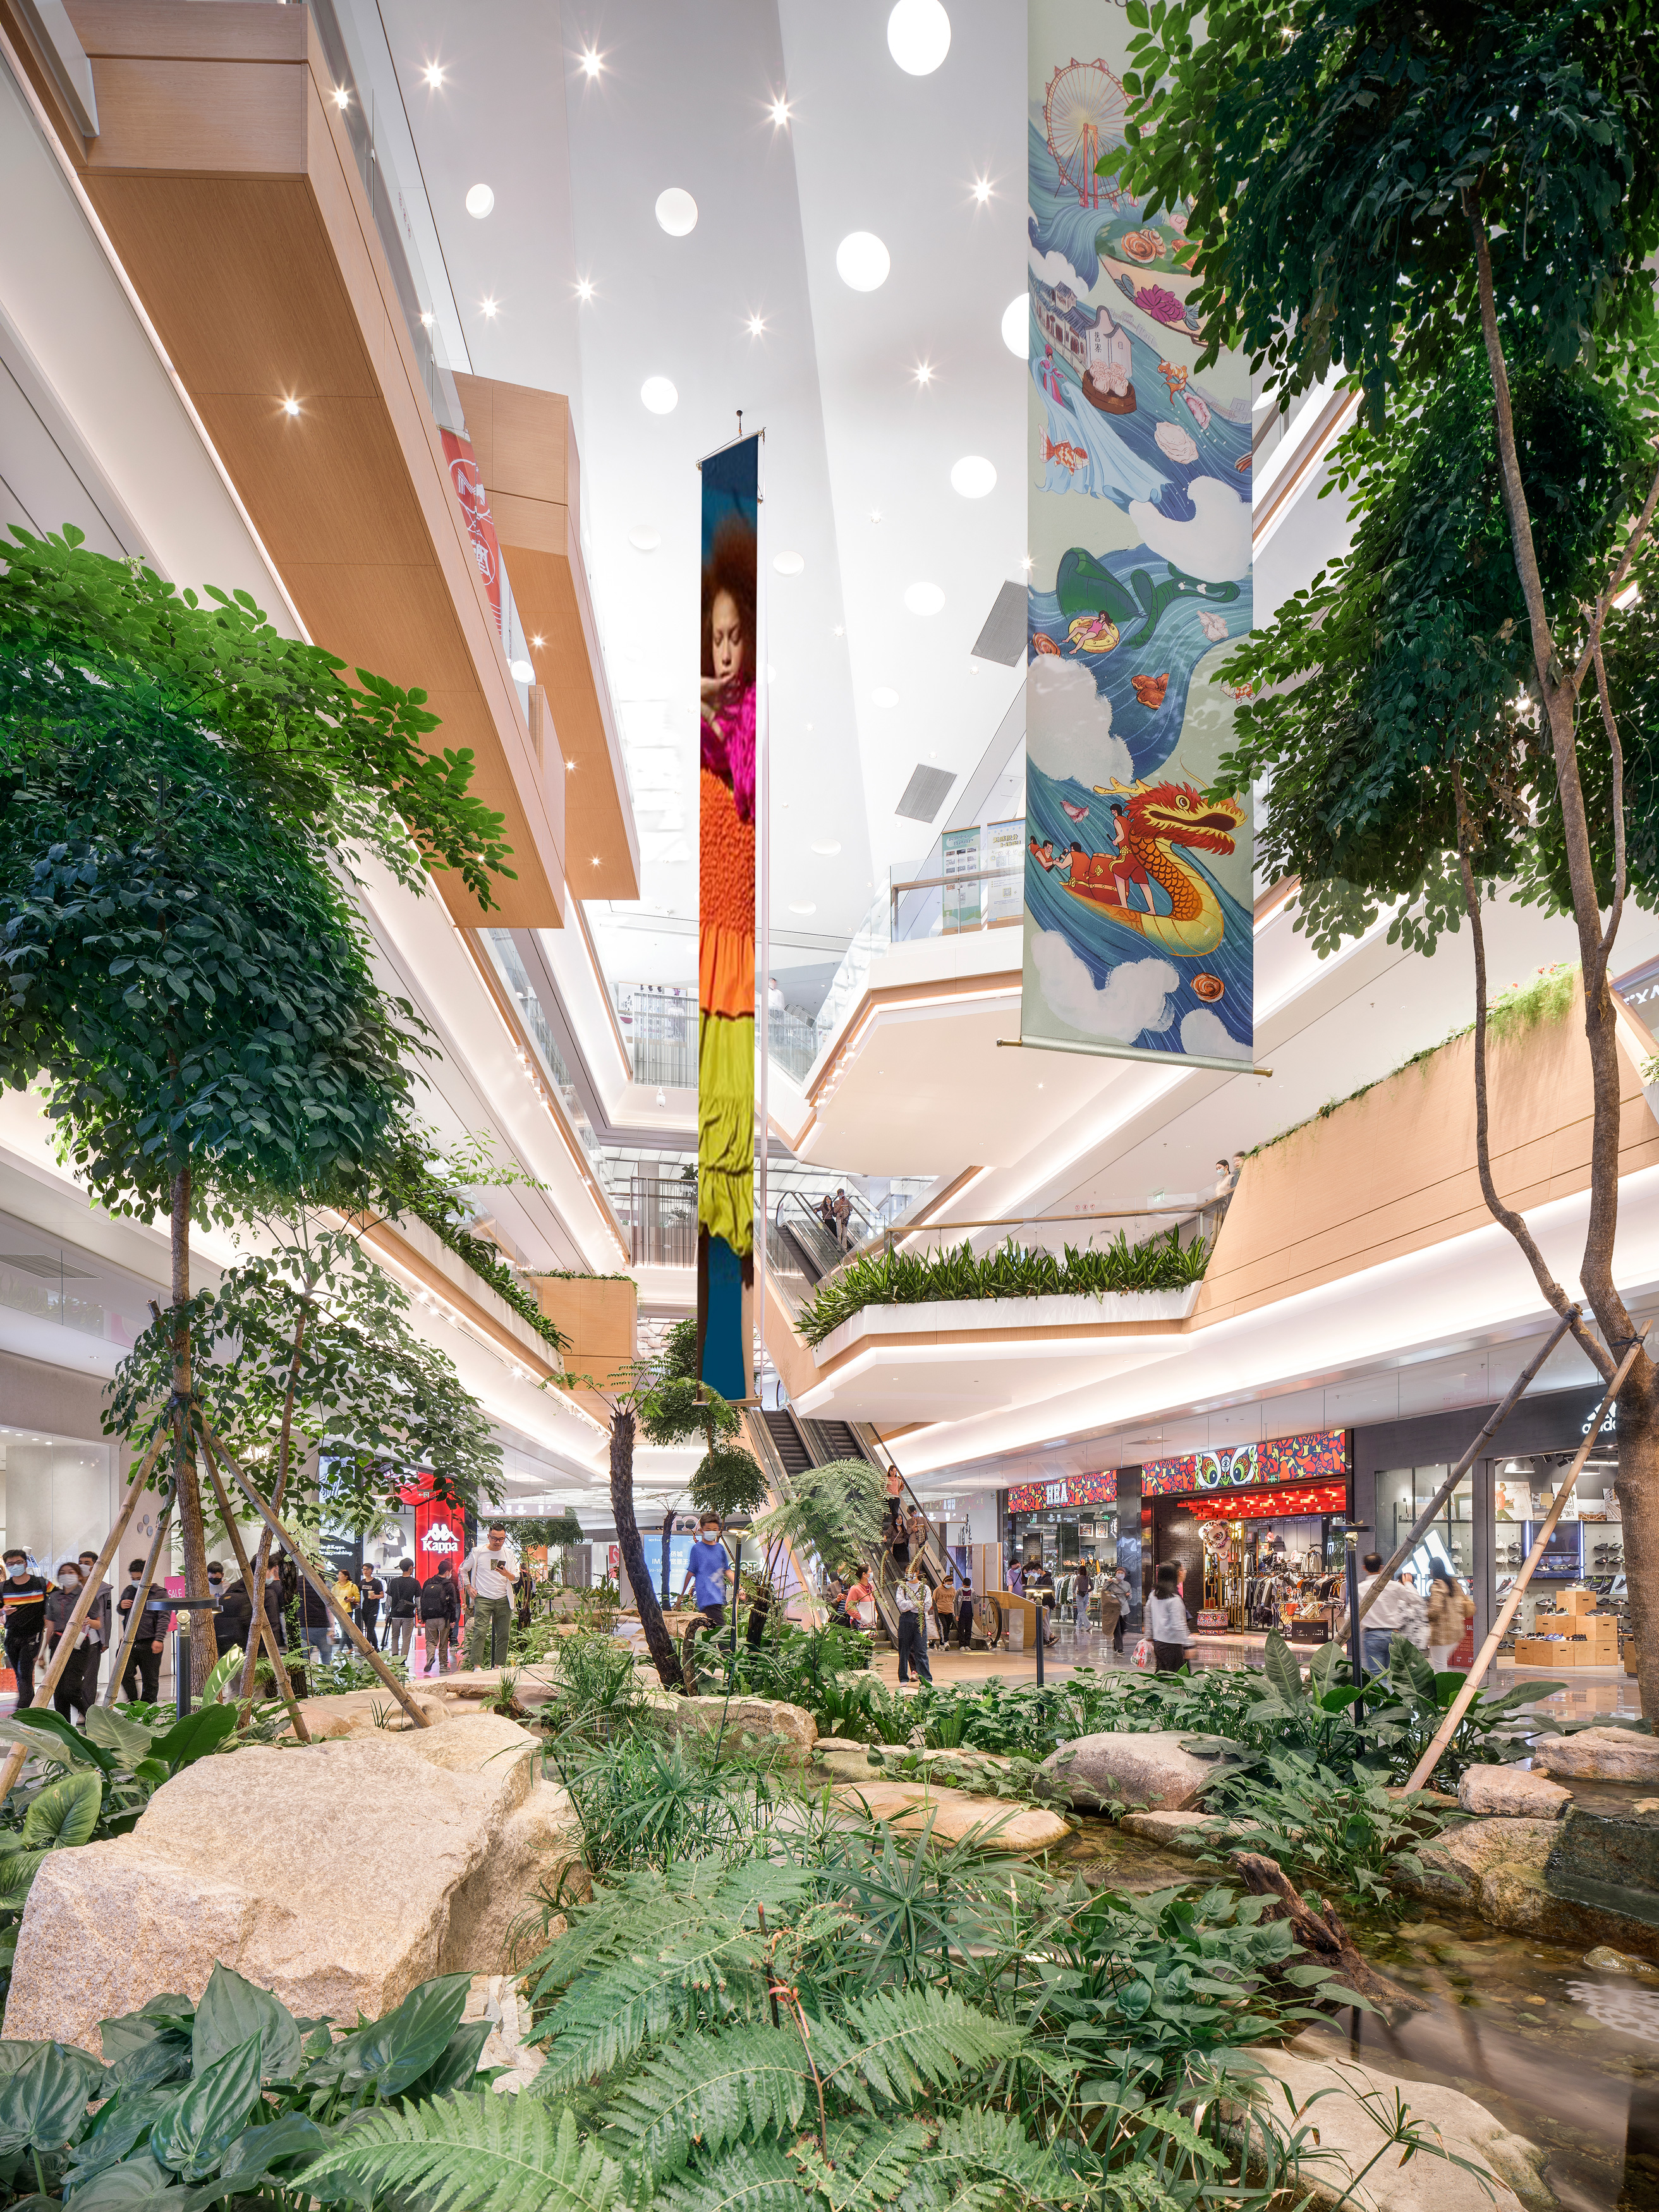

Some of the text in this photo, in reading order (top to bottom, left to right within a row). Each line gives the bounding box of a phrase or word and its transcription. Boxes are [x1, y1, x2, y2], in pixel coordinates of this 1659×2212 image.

[1046, 1482, 1068, 1505] HEA
[422, 1540, 458, 1553] Kappa
[167, 1588, 183, 1598] SALE
[988, 1610, 995, 1624] L1
